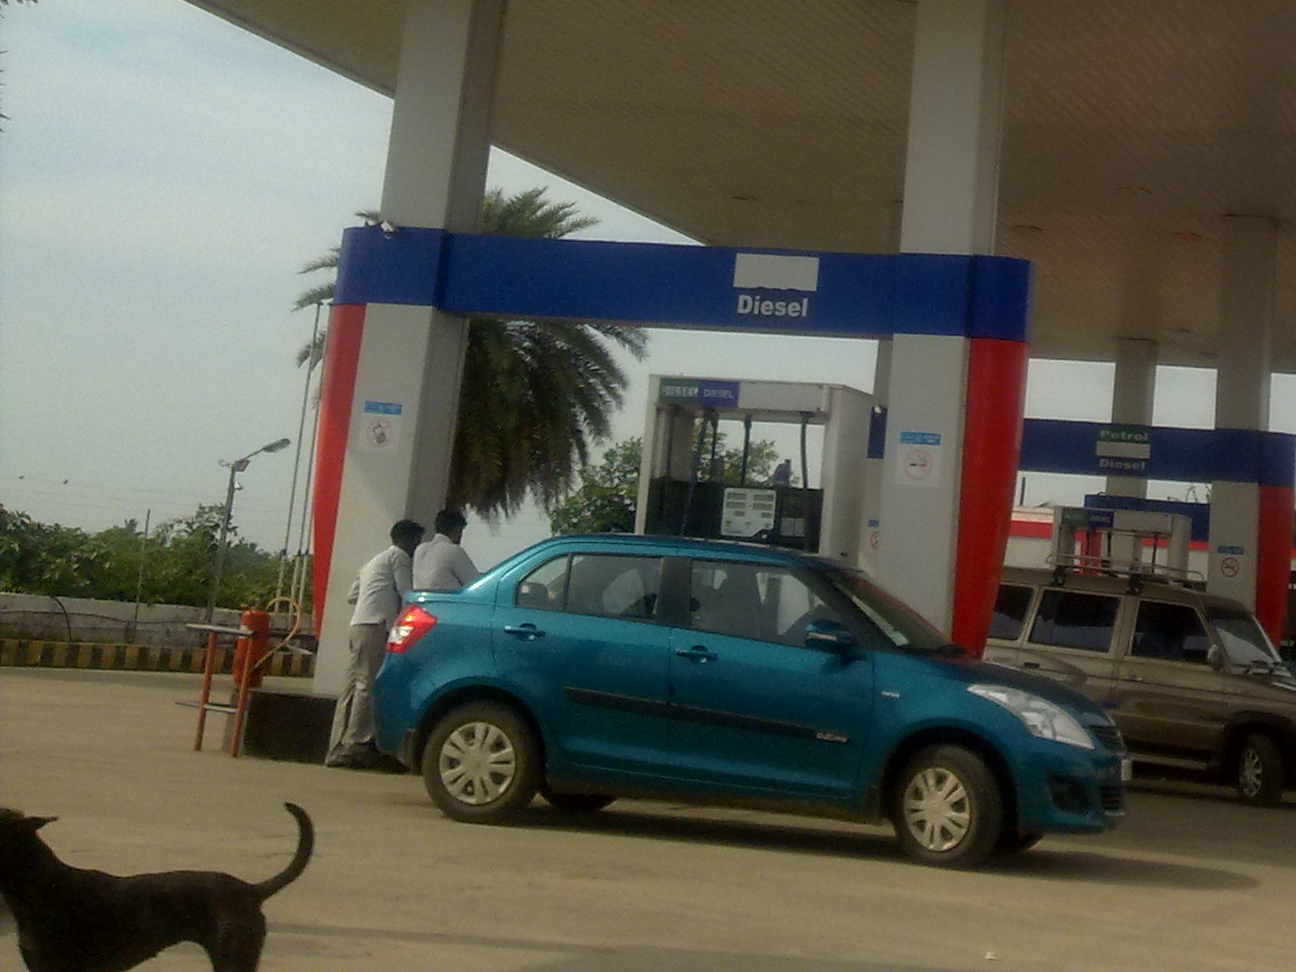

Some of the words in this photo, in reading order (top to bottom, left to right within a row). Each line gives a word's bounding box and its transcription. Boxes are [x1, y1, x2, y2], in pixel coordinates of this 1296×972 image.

[737, 294, 809, 317] Diesel
[1100, 429, 1149, 442] Petrol
[1099, 458, 1146, 470] Diesel
